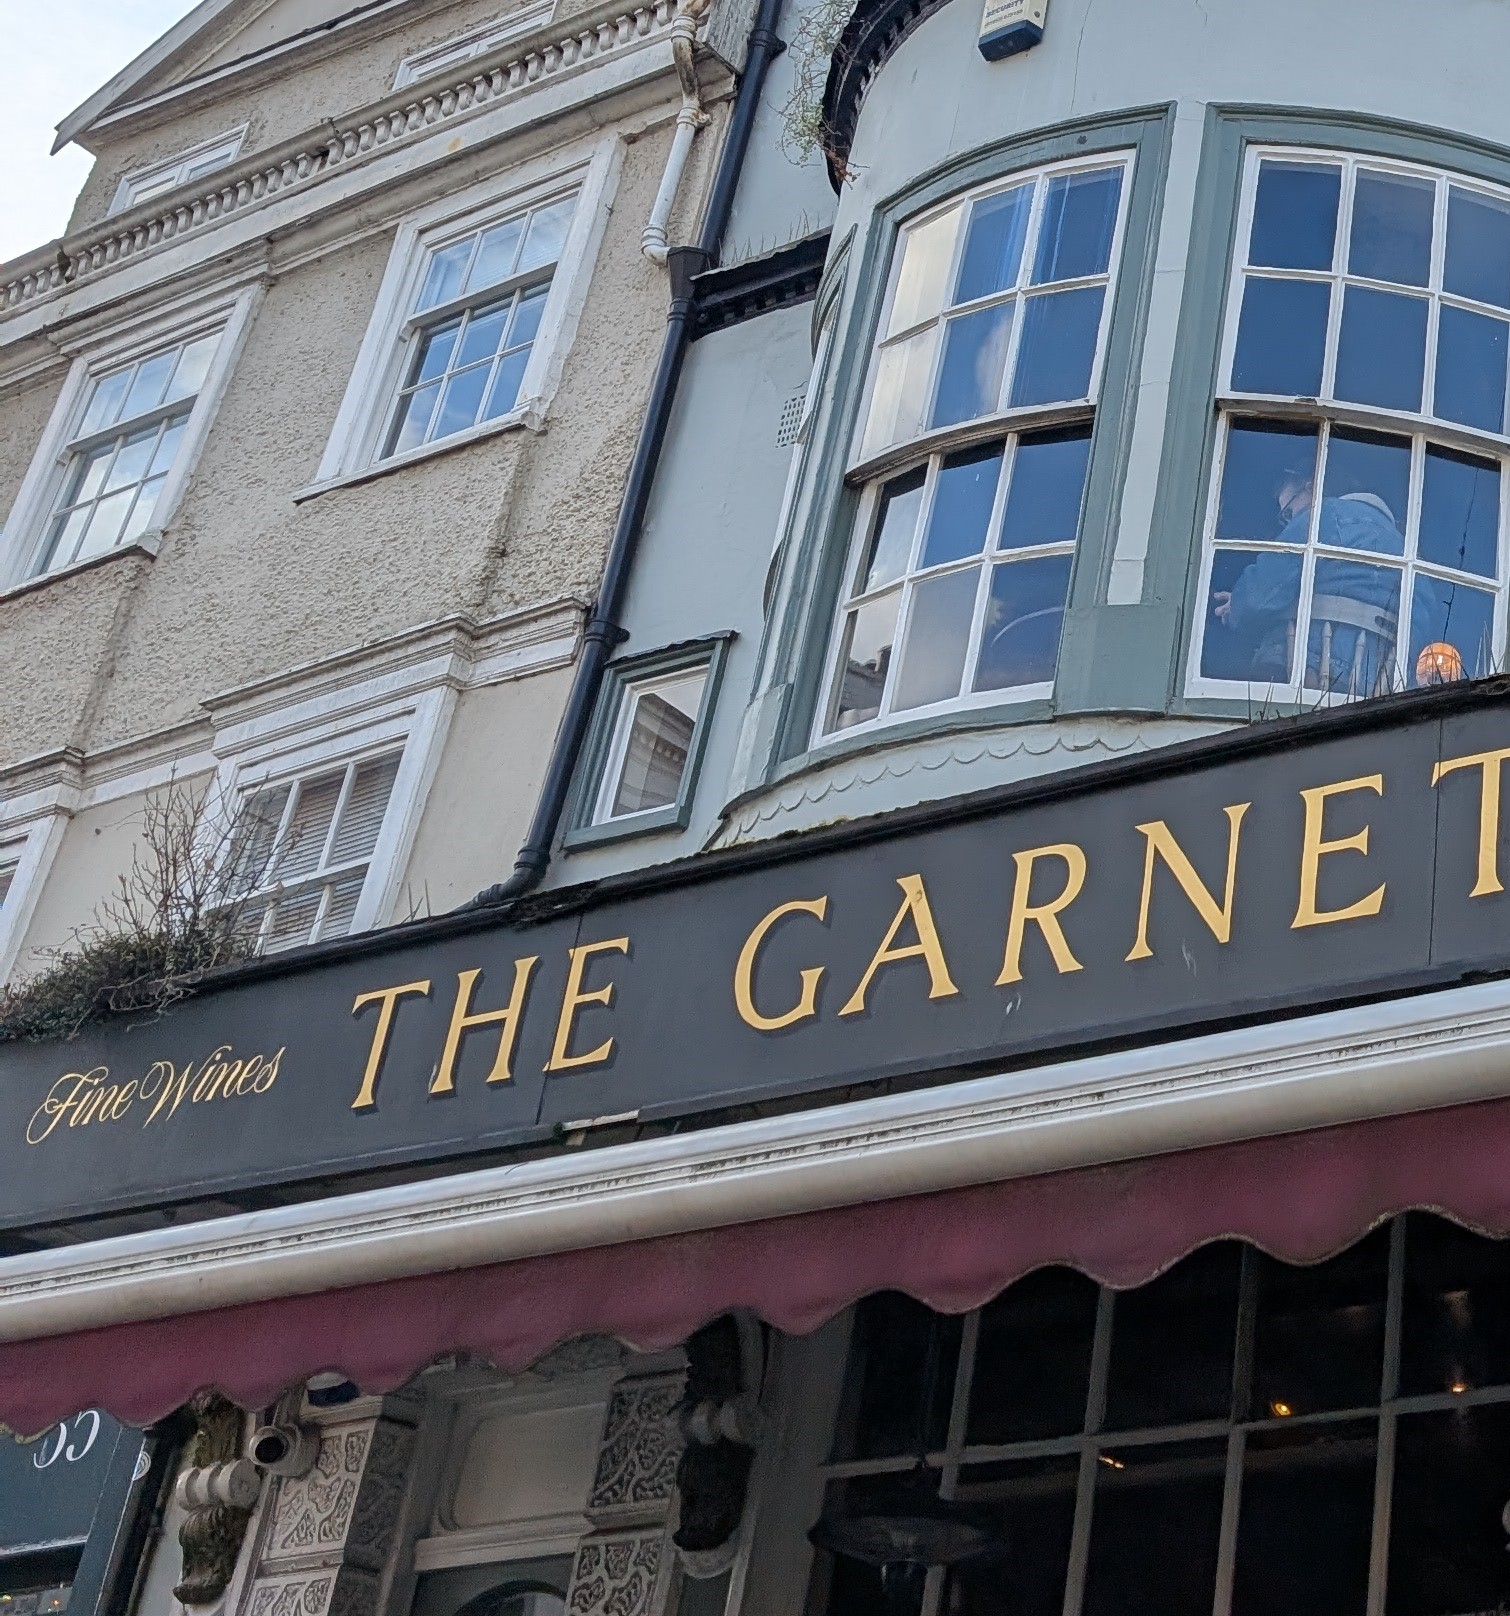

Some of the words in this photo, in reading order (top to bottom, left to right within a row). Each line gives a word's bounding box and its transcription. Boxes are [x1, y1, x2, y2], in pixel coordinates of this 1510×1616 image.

[350, 936, 629, 1110] THE
[26, 1065, 136, 1145] Fine
[139, 1044, 287, 1131] Wines
